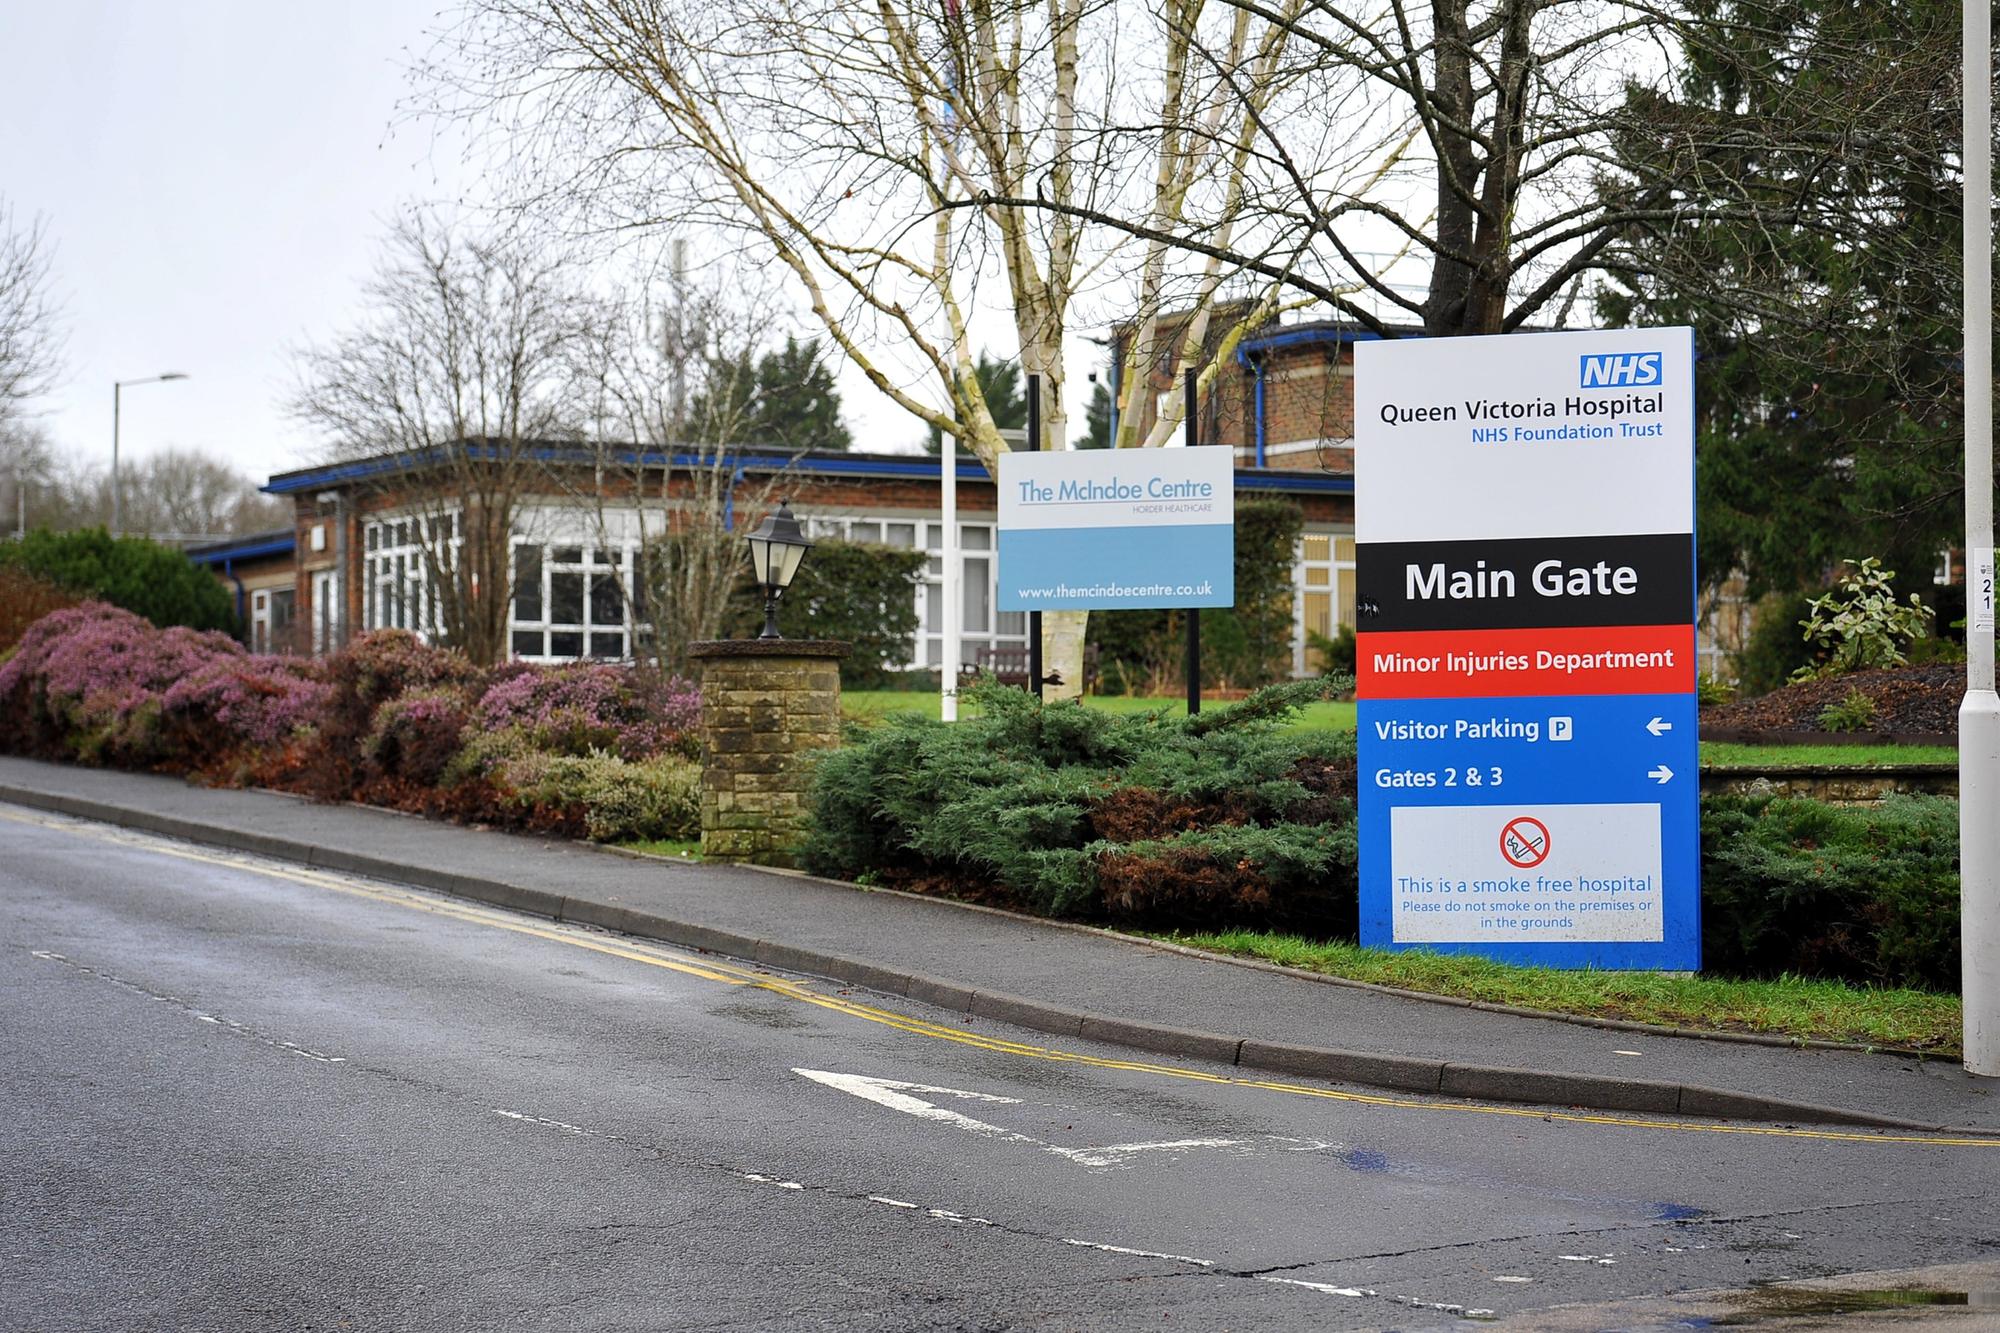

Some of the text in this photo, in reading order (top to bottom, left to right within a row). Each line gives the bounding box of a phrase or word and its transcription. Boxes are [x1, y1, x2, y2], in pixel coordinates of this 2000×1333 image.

[1583, 355, 1658, 386] NHS
[1380, 393, 1663, 427] Queen Victoria Hospital
[1472, 423, 1662, 442] NHS Foundation Trust
[1019, 478, 1212, 501] The McIndoe Centre
[1133, 504, 1212, 514] HORDER HEALTHCARE
[1018, 581, 1213, 598] www.themcindoecentre.co.uk
[1407, 560, 1637, 599] Main Gate
[1374, 650, 1674, 675] Minor Injuries Department
[1375, 720, 1448, 739] Visitor
[1456, 718, 1538, 742] Parking
[1376, 767, 1502, 787] Gates 2 & 3
[1398, 875, 1650, 895] This is a smoke free hospital
[1402, 900, 1652, 913] Please do not smoke on the premises or
[1480, 916, 1572, 930] in the grounds
